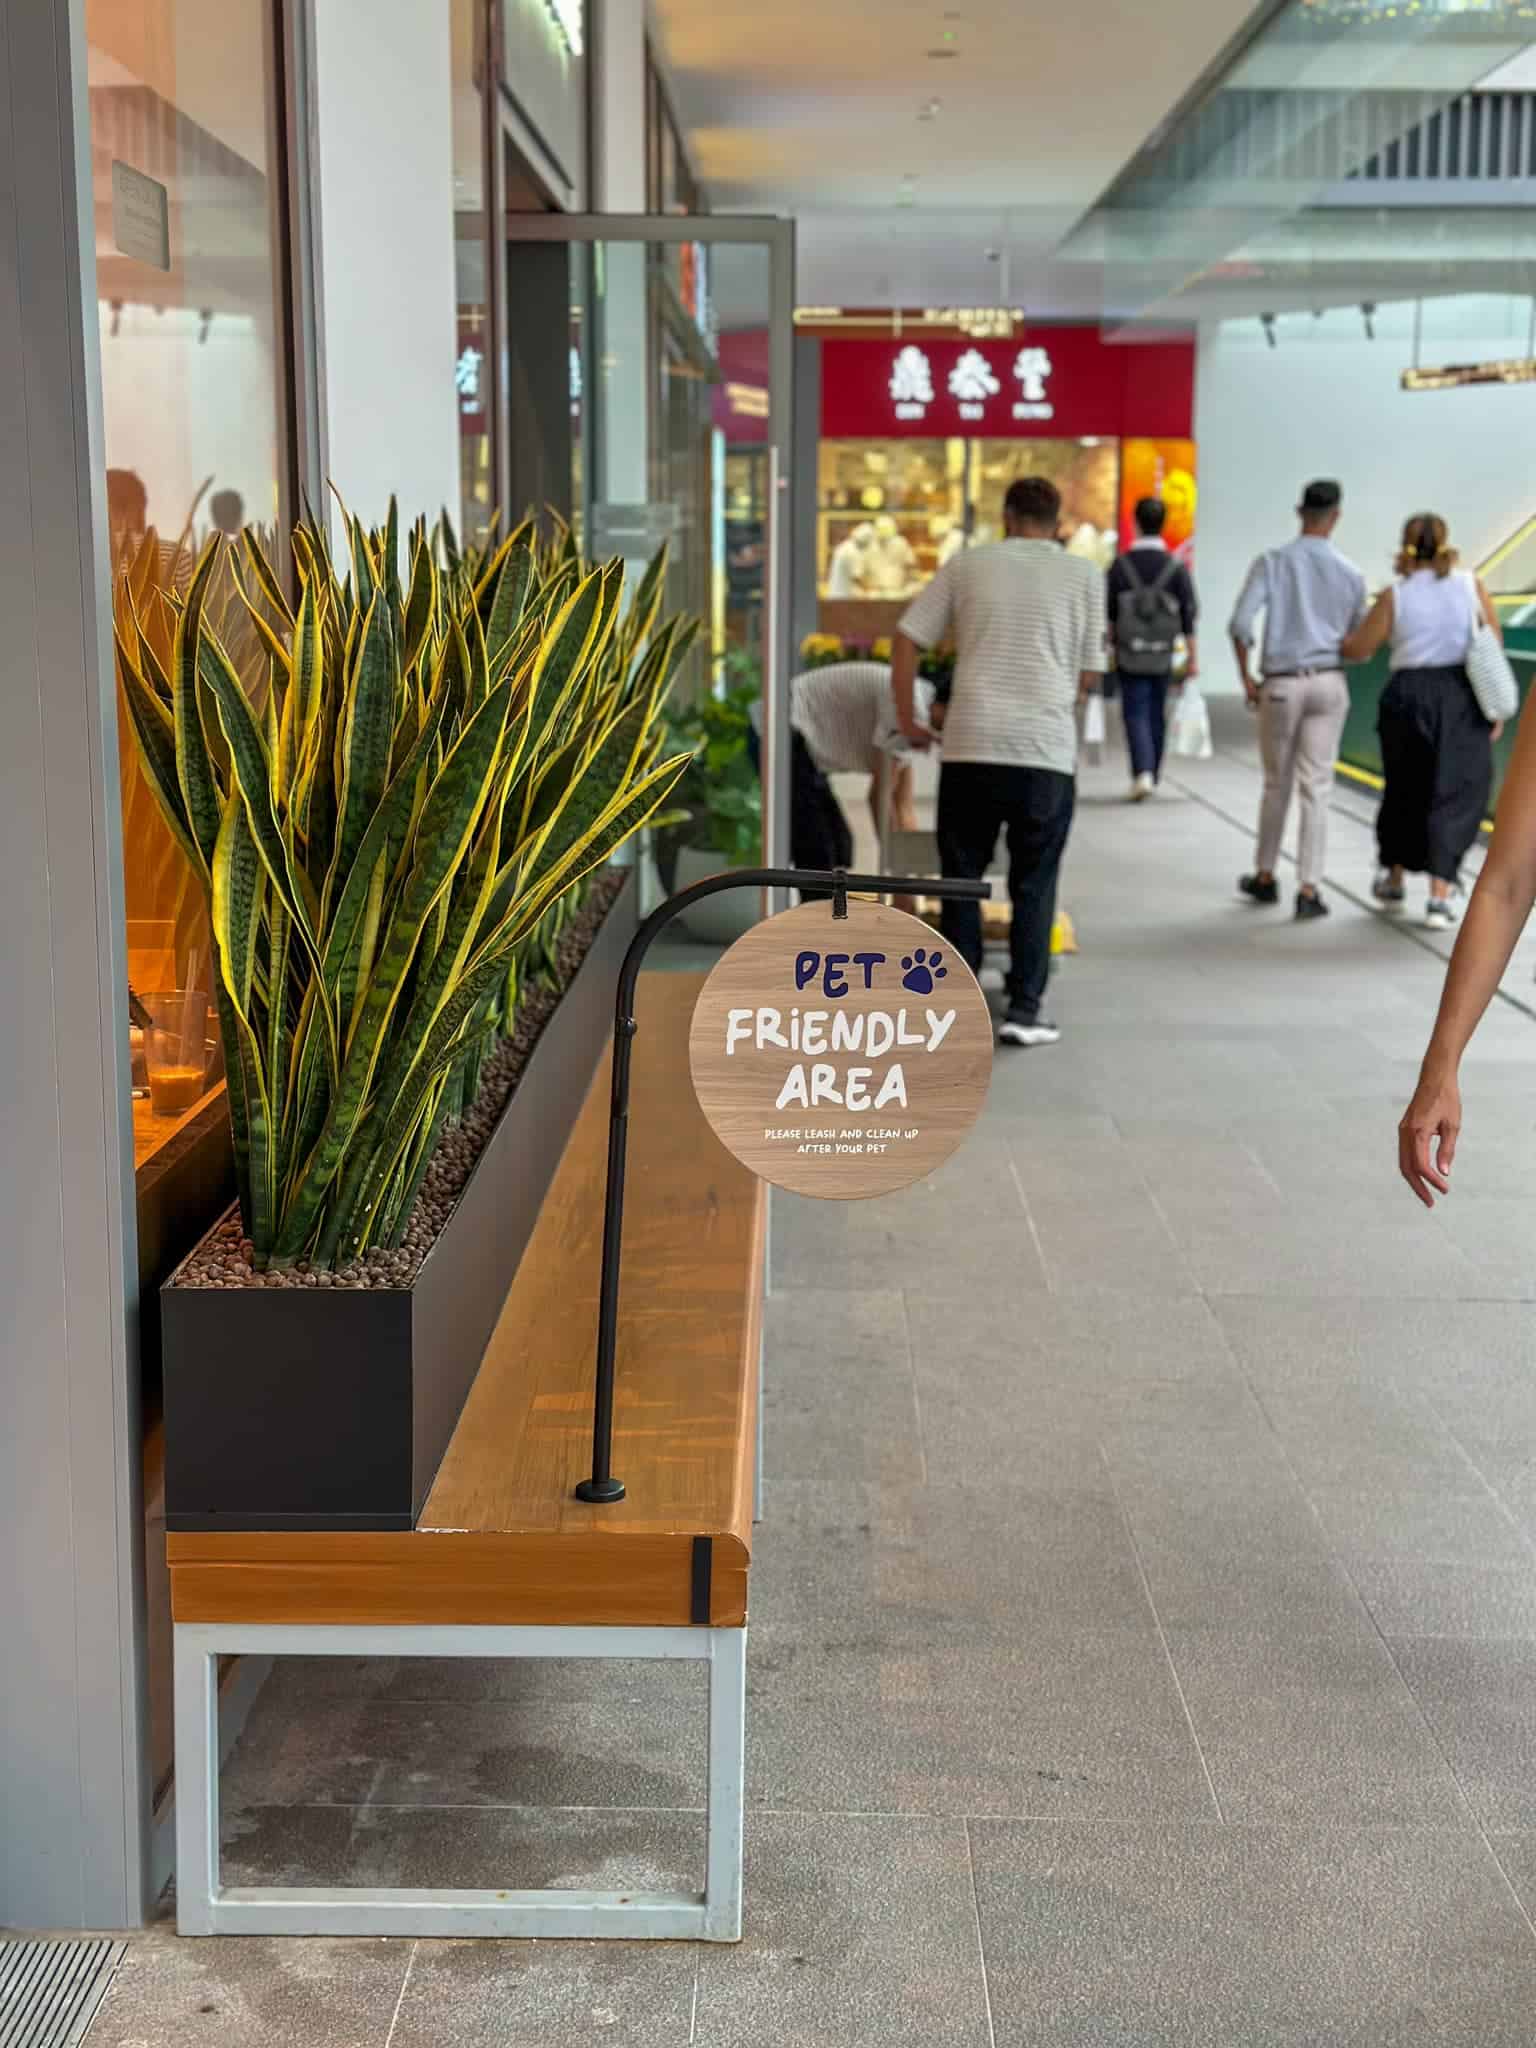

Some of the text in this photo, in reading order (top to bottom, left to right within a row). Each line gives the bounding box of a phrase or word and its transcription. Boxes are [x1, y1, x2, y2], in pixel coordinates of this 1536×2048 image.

[795, 951, 886, 998] PET
[775, 1063, 908, 1112] AREA
[765, 1128, 801, 1140] PLEASE
[804, 1128, 836, 1140] LEASH
[839, 1128, 864, 1140] AND
[866, 1128, 901, 1140] CLEAN
[797, 1143, 832, 1154] AFTER
[866, 1143, 888, 1154] PET
